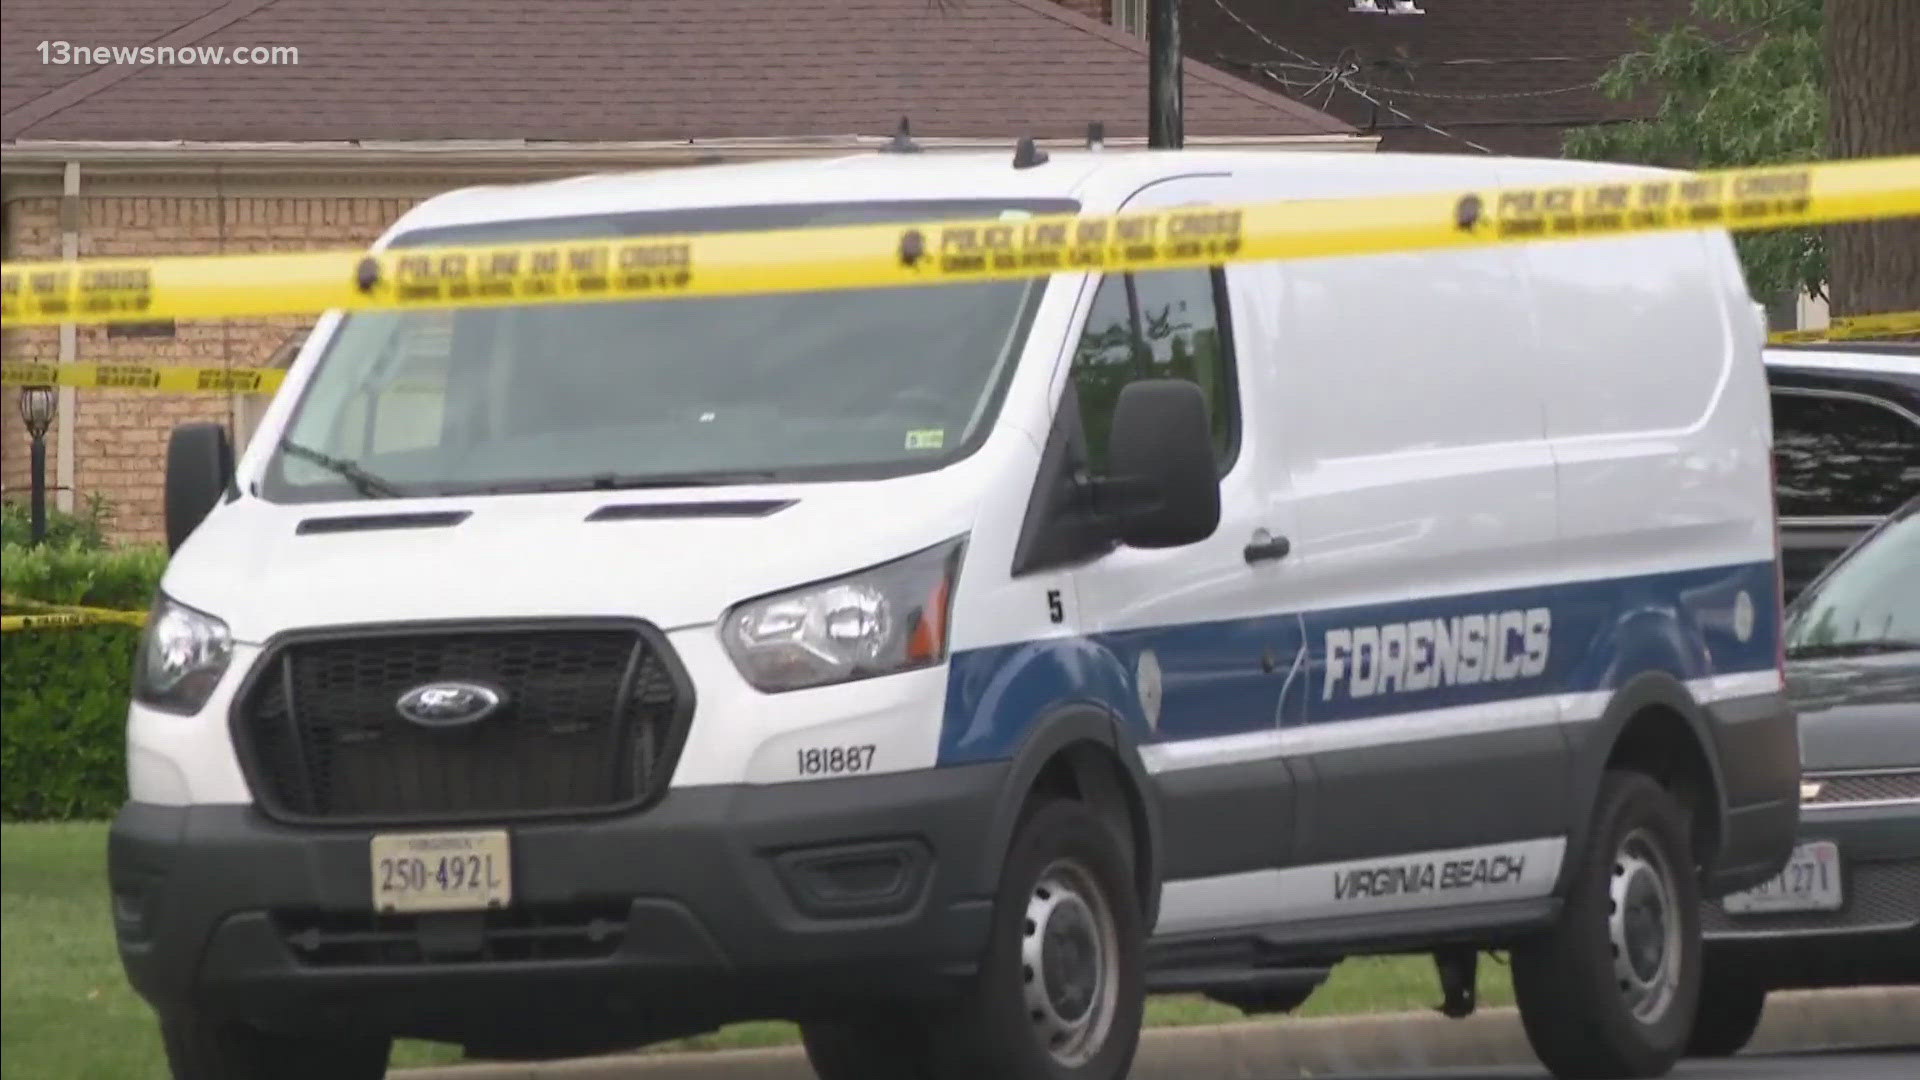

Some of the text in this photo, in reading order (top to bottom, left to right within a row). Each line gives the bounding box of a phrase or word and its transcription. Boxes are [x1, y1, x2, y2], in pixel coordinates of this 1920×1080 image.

[1047, 590, 1063, 624] 5
[1323, 607, 1552, 701] FORENSICS
[797, 744, 876, 775] 181887
[1334, 854, 1525, 900] VIRGINIA BEACH
